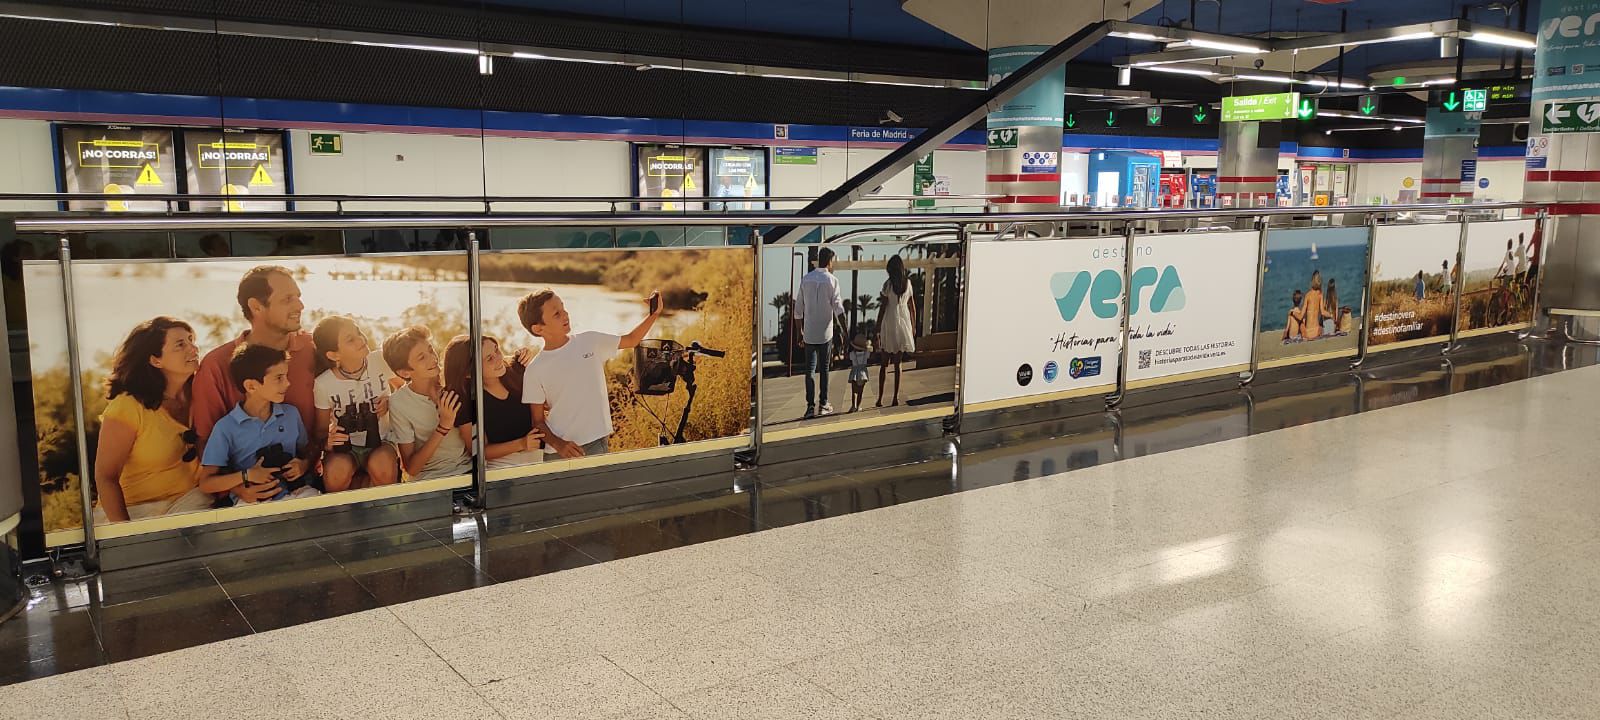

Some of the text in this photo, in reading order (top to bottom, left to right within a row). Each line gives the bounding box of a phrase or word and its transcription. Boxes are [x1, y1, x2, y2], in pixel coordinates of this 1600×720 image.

[1234, 95, 1258, 106] Salida
[1263, 96, 1277, 105] Exit
[851, 129, 907, 139] Feria de Madrid
[82, 149, 156, 160] ¡NO CORRAS!
[201, 151, 268, 161] ¡NO CORRAS!
[1092, 245, 1154, 259] destno
[1374, 310, 1415, 322] #destinovera
[1372, 321, 1424, 336] #destinofamiliar
[1095, 336, 1118, 352] para
[1145, 324, 1155, 338] la
[1155, 340, 1235, 357] DESCUBRE TODAS LAS HISTORIAS
